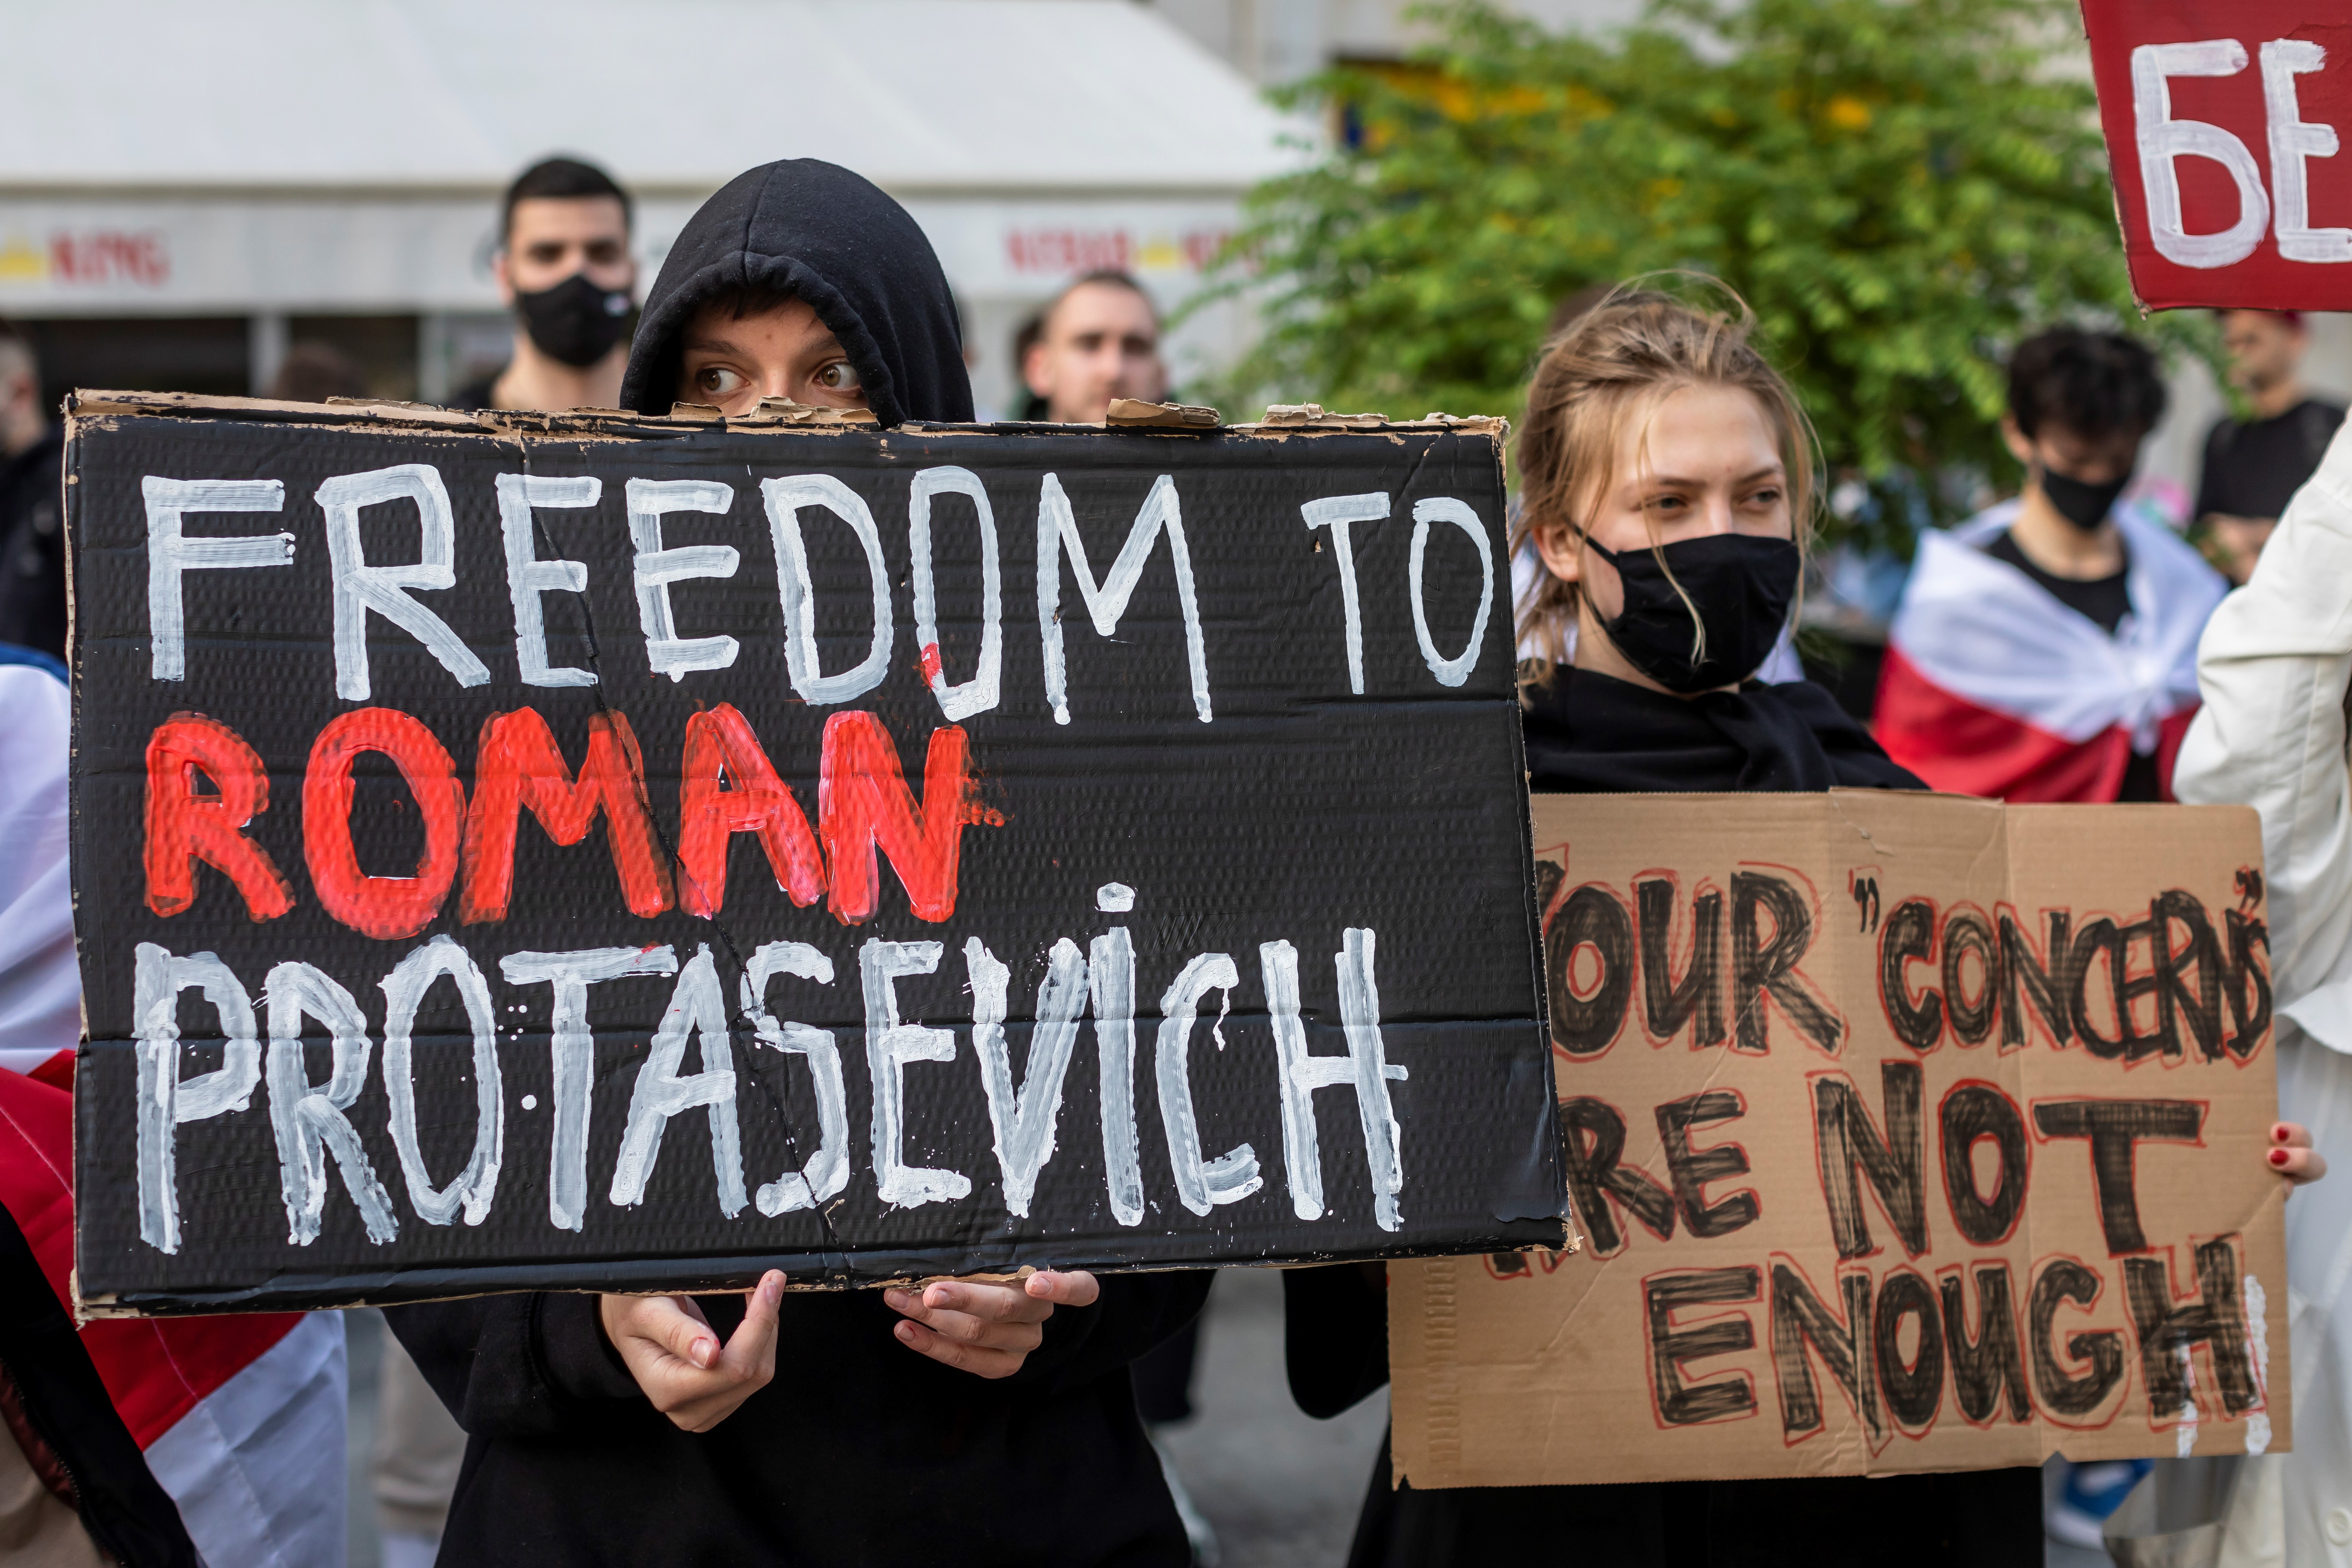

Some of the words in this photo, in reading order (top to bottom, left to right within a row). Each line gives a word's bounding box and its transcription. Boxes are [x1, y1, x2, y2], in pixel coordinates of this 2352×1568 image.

[2130, 38, 2352, 269] БЕ
[141, 464, 1212, 725] FREEDOM
[1300, 491, 1493, 694] TO
[143, 701, 976, 940] ROMAN
[1483, 1087, 1762, 1280] RE
[1805, 1059, 2210, 1260] NOT
[1641, 1232, 2268, 1457] ENOUGH
